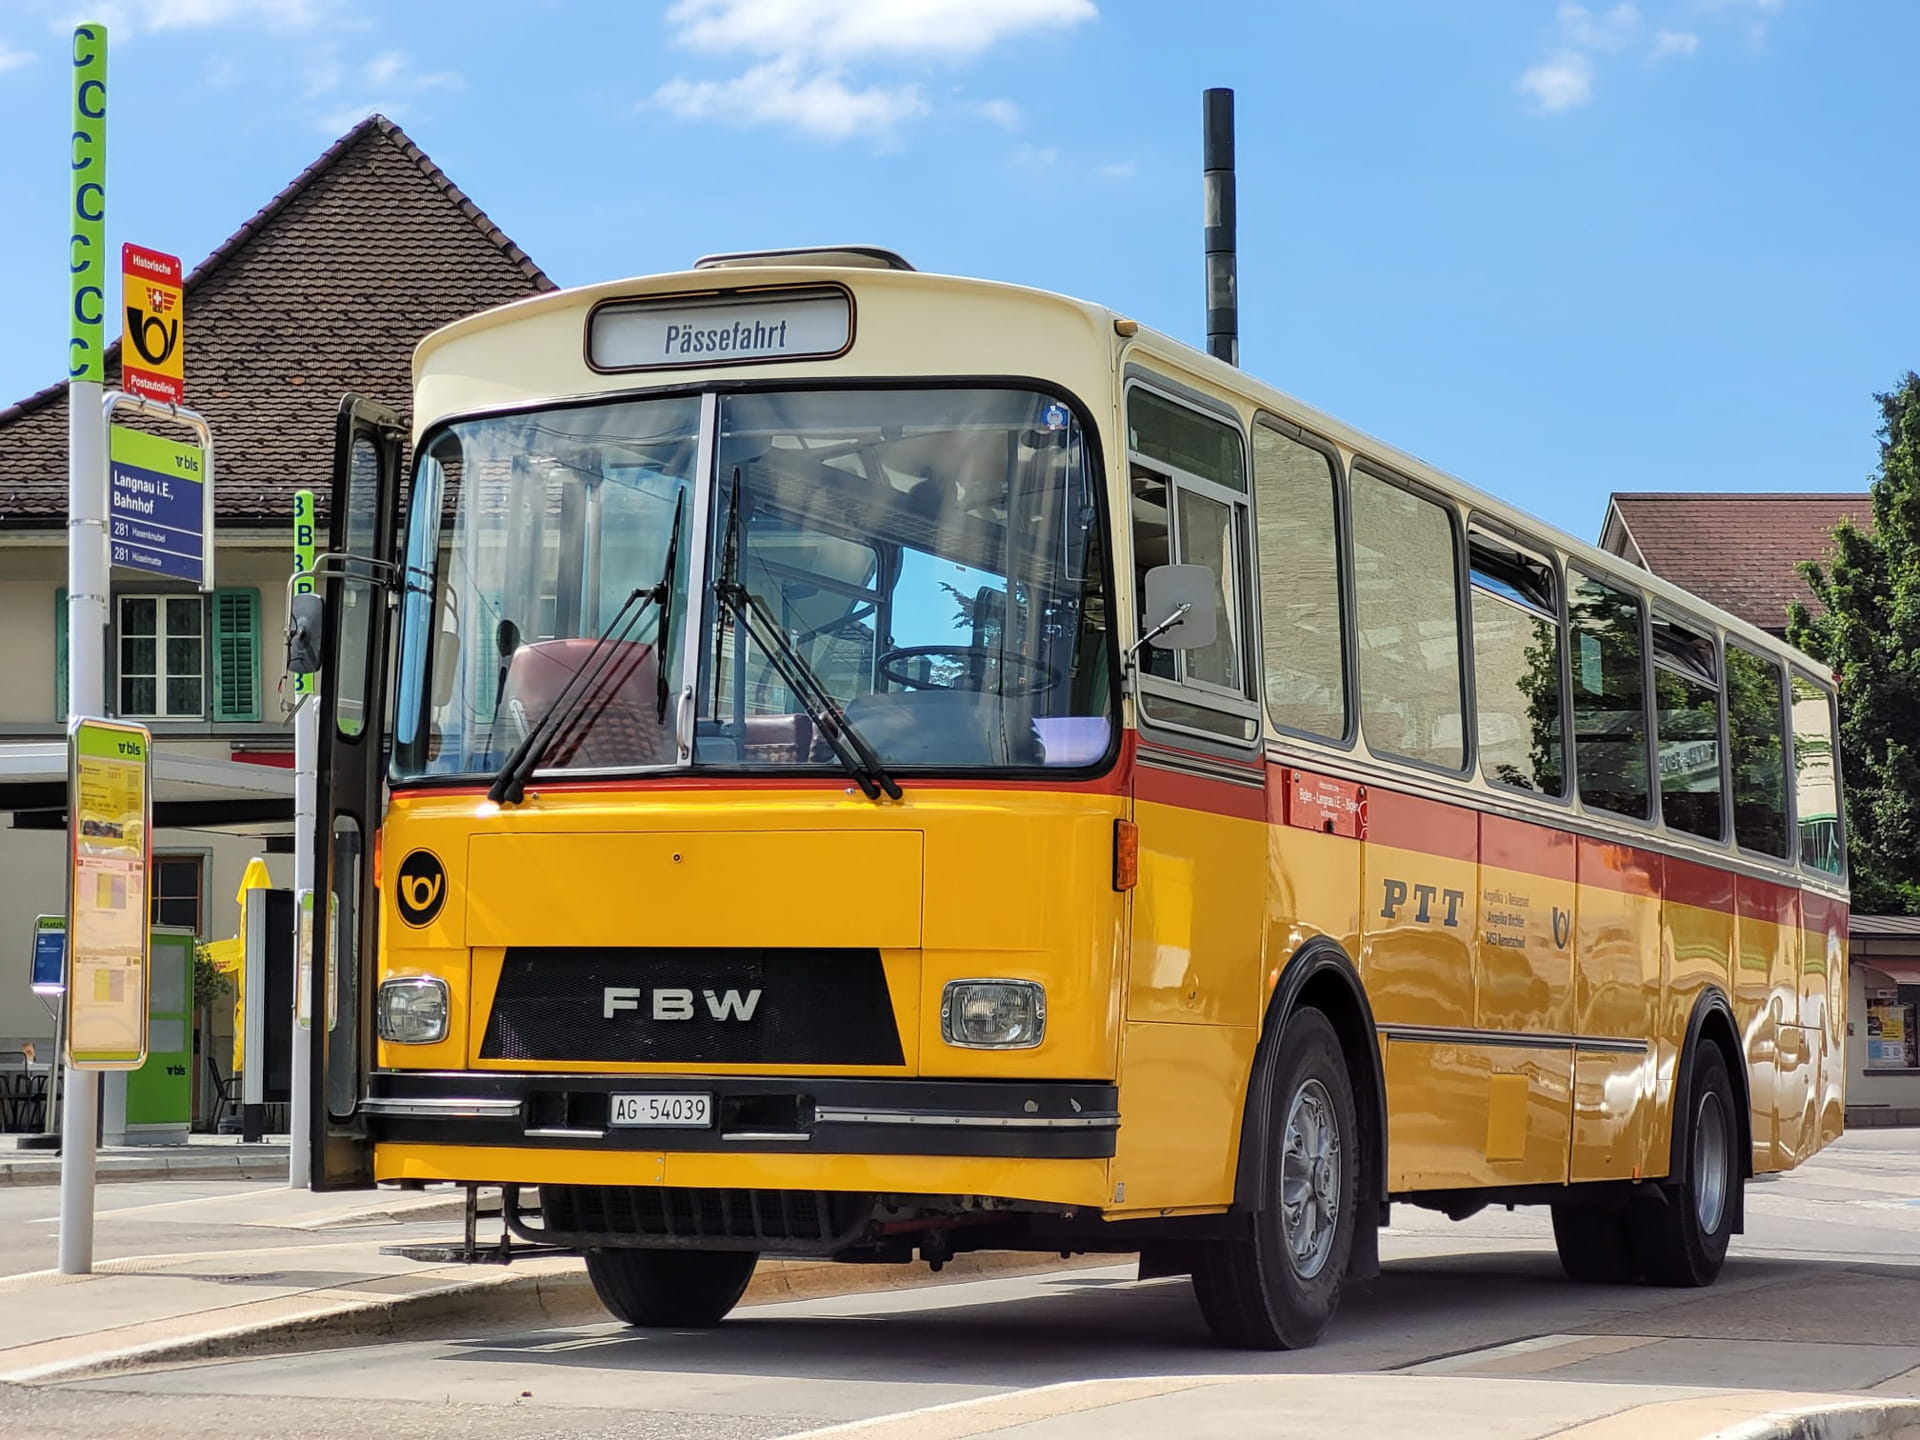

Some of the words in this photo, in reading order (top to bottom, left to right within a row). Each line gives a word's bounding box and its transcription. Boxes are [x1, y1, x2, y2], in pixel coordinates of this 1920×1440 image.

[73, 28, 94, 67] C
[78, 80, 106, 119] C
[71, 131, 92, 170] C
[76, 183, 104, 222] C
[70, 234, 90, 274] C
[132, 254, 172, 276] Historische
[75, 286, 103, 325] C
[664, 320, 787, 354] Pässefahrt
[68, 338, 89, 377] C
[130, 374, 176, 396] Postautolinie
[184, 456, 198, 472] bls
[114, 469, 154, 494] Langnau
[156, 481, 174, 501] i.E.,
[114, 492, 154, 515] Bahnhof
[114, 522, 128, 536] 281
[298, 525, 312, 546] B
[114, 546, 128, 562] 281
[127, 742, 141, 755] bls
[1380, 878, 1464, 928] PTT
[603, 988, 762, 1022] FBW
